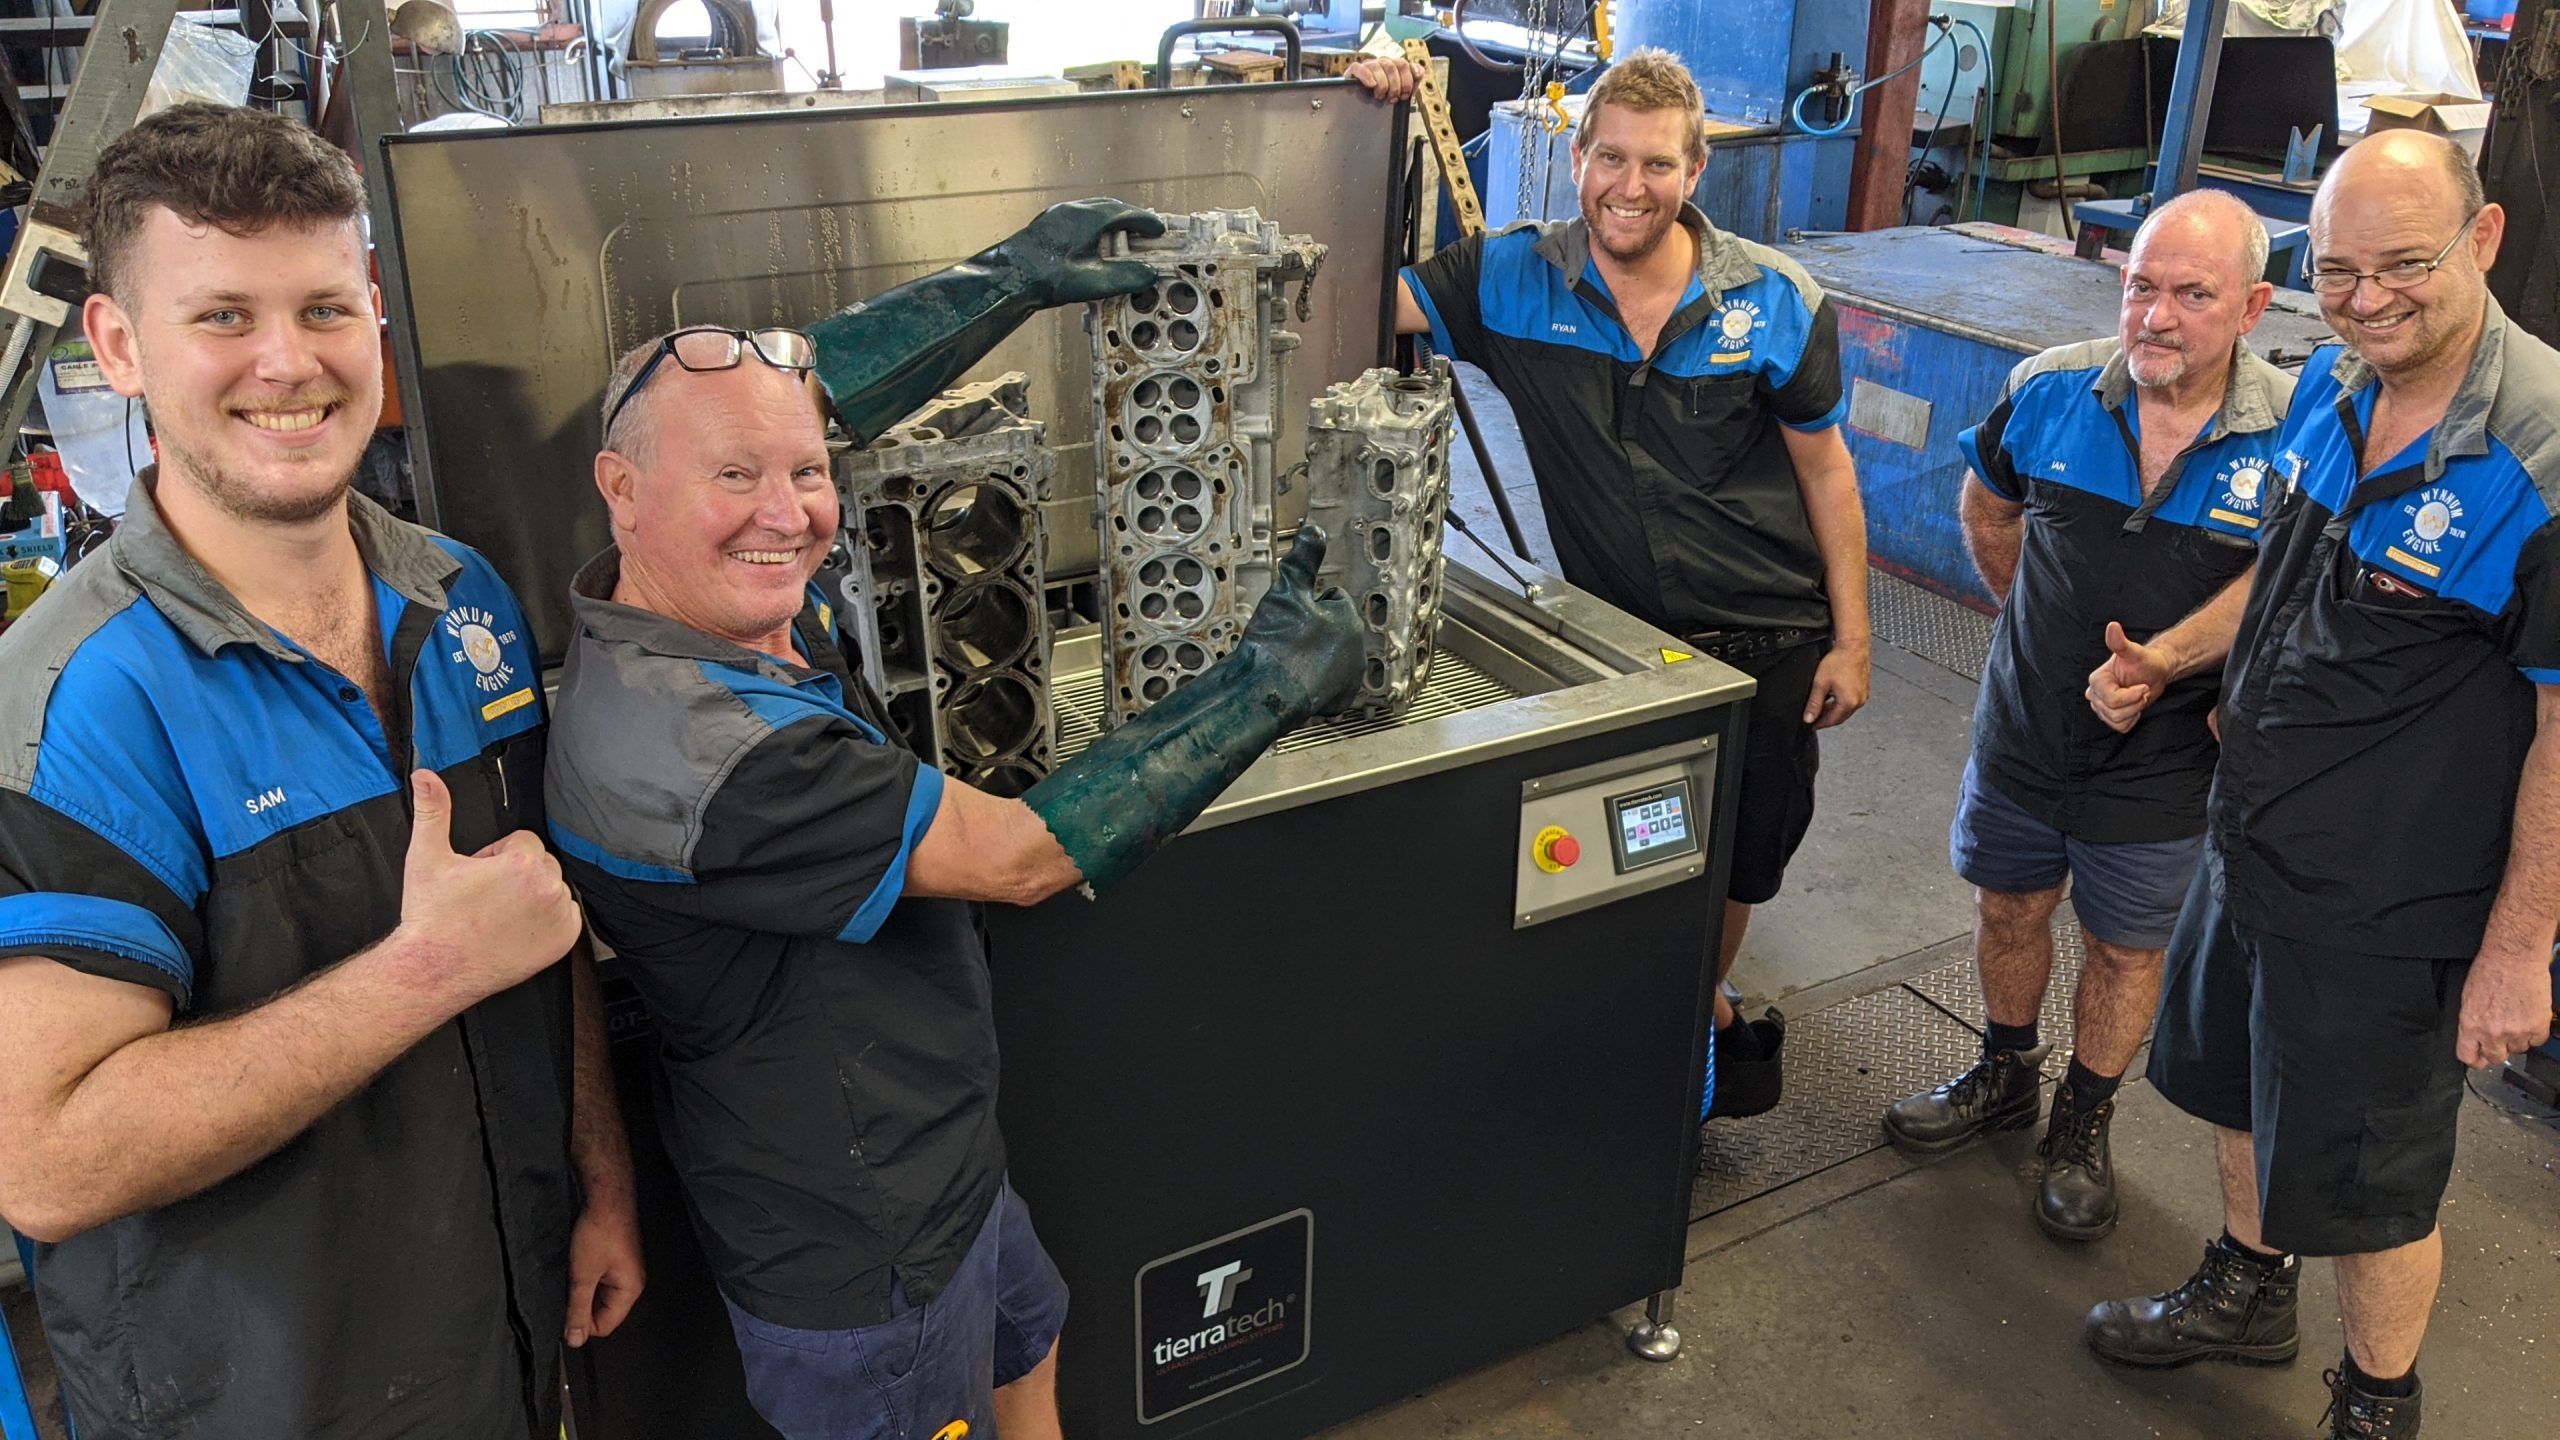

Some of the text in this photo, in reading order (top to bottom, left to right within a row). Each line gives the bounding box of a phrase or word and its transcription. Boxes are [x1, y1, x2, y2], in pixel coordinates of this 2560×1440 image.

[1717, 298, 1761, 316] WYNNUM
[1552, 322, 1577, 334] RYAN
[1717, 335, 1750, 350] ENGINE
[2051, 460, 2067, 472] IAN
[2229, 456, 2269, 473] WYNNU
[2221, 492, 2260, 511] ENGINE
[2421, 487, 2464, 519] WYNNUM
[21, 544, 54, 554] SHIELD
[2402, 528, 2442, 555] ENGINE
[445, 606, 494, 638] WYNNUM
[498, 630, 517, 645] 1976
[476, 661, 514, 692] ENGINE
[246, 786, 286, 815] SAM
